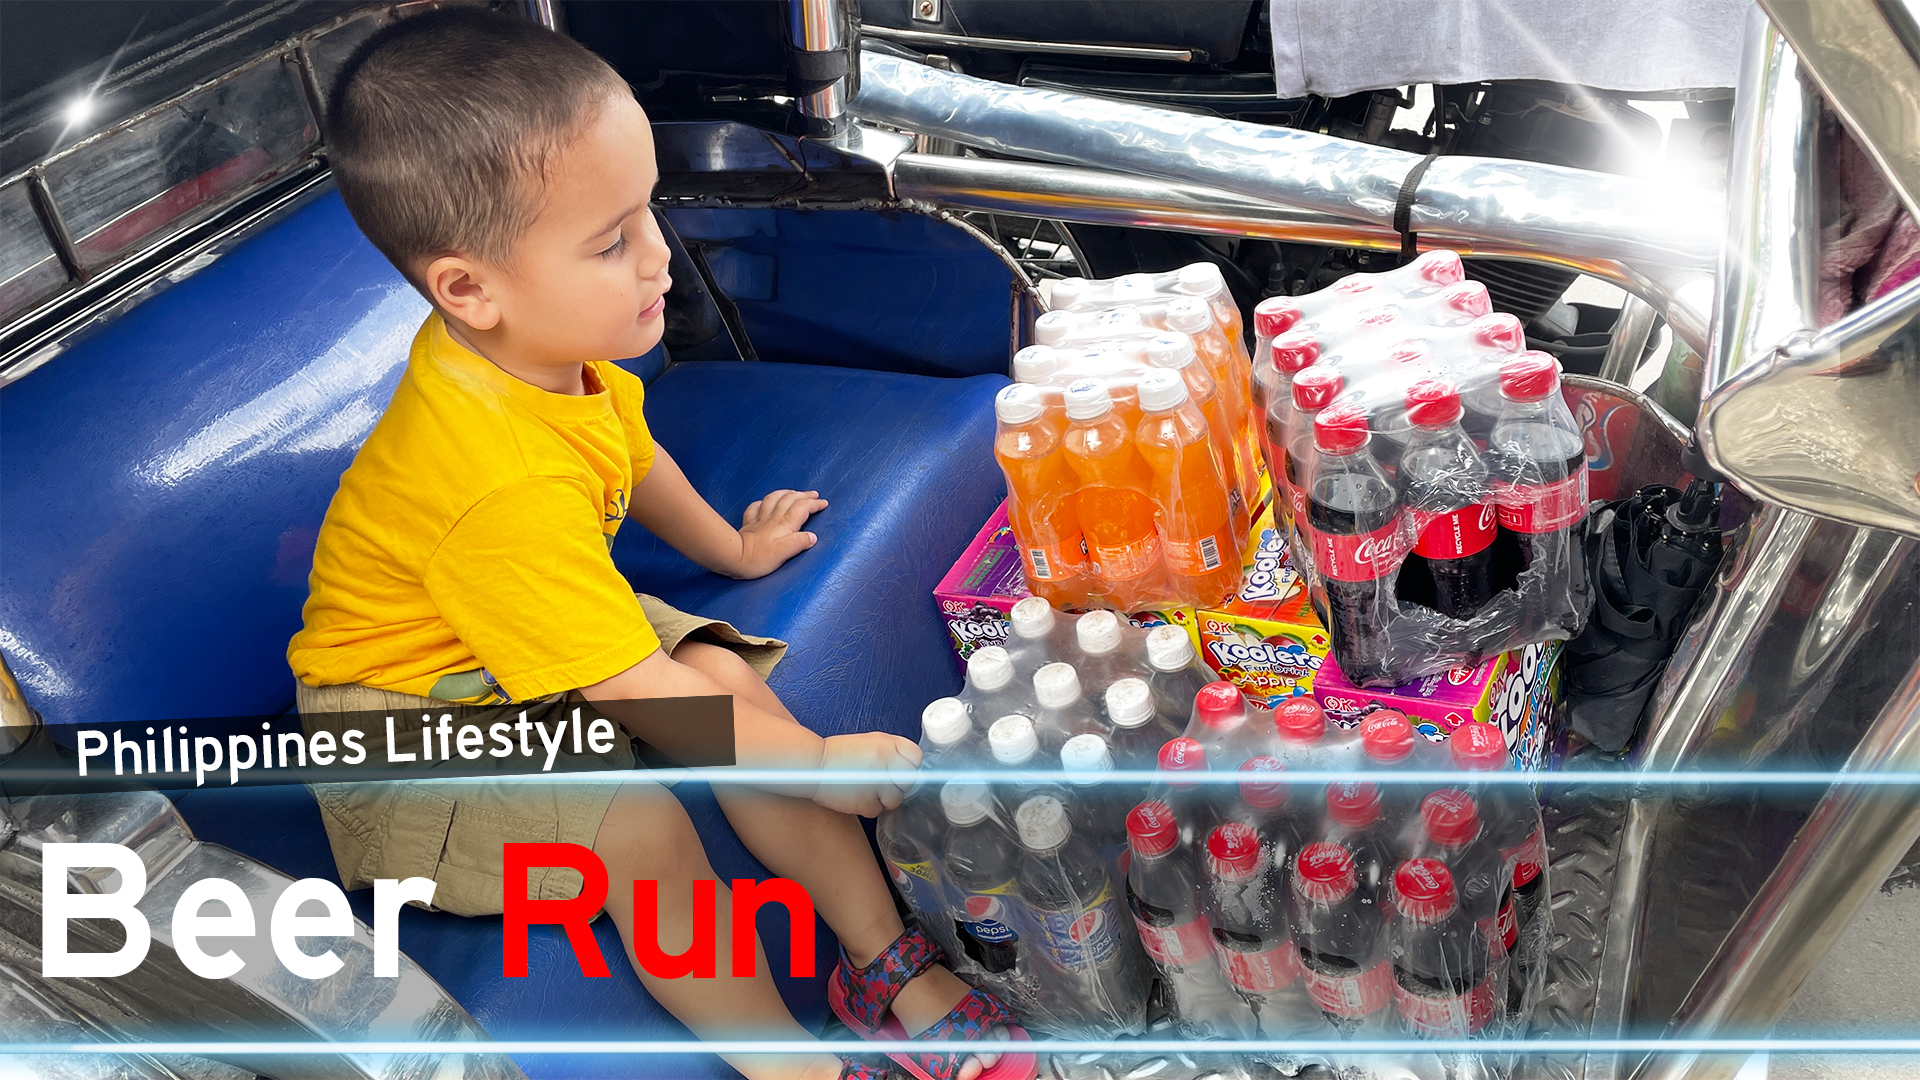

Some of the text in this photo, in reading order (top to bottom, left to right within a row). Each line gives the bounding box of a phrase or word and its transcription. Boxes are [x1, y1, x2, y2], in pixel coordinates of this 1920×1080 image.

[1452, 514, 1463, 555] RECYCLE ME
[1326, 537, 1339, 577] RECYCLE ME
[1206, 620, 1231, 634] OK
[1208, 642, 1325, 671] Koolers
[1273, 665, 1311, 677] Drink
[1240, 675, 1299, 688] Apple
[1324, 696, 1354, 712] OK
[975, 925, 1010, 935] pepsi
